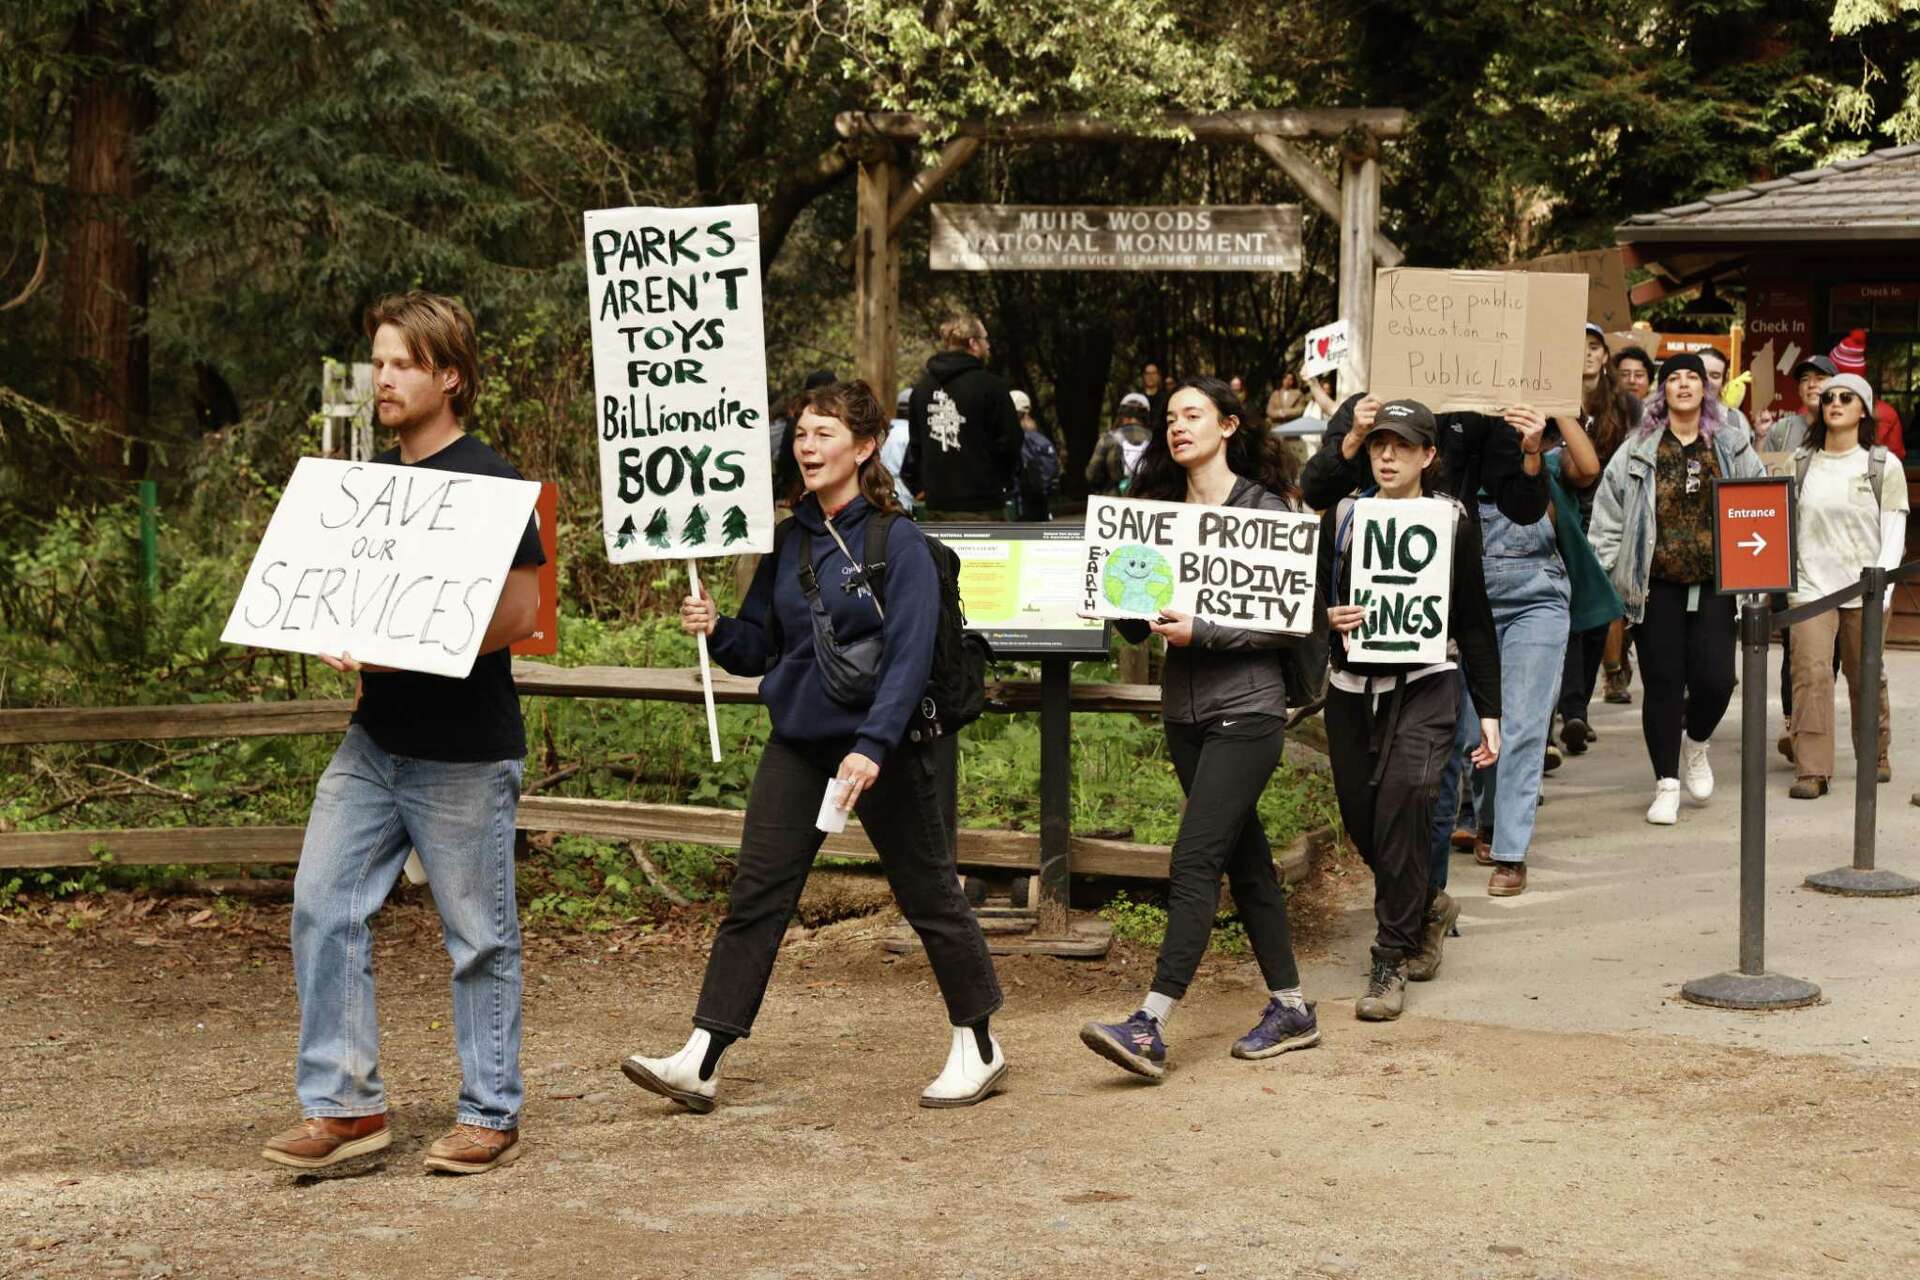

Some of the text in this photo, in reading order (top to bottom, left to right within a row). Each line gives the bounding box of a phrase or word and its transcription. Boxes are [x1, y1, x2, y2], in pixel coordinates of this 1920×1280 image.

[1019, 211, 1211, 231] MUIR WOODS
[592, 220, 736, 276] PARKS
[965, 232, 1268, 252] NATIONAL MONUMENT
[1021, 254, 1055, 265] PARK
[1204, 255, 1222, 265] OF
[600, 267, 749, 322] AREN'T
[1390, 274, 1524, 323] Keep public
[1860, 286, 1889, 297] Check
[618, 318, 725, 354] TOYS
[1388, 312, 1509, 340] education in
[1750, 319, 1805, 333] Check In
[627, 359, 708, 388] FOR
[1407, 350, 1553, 391] Public Lands
[617, 444, 746, 504] BOYS
[320, 466, 472, 531] SAVE
[1727, 507, 1776, 519] Entrance
[351, 536, 397, 561] OUR
[1097, 505, 1320, 555] SAVE PROTECT
[1363, 517, 1438, 574] NO
[1084, 546, 1102, 611] EARTH
[245, 561, 492, 656] SERVICES
[1196, 588, 1301, 628] RSITY
